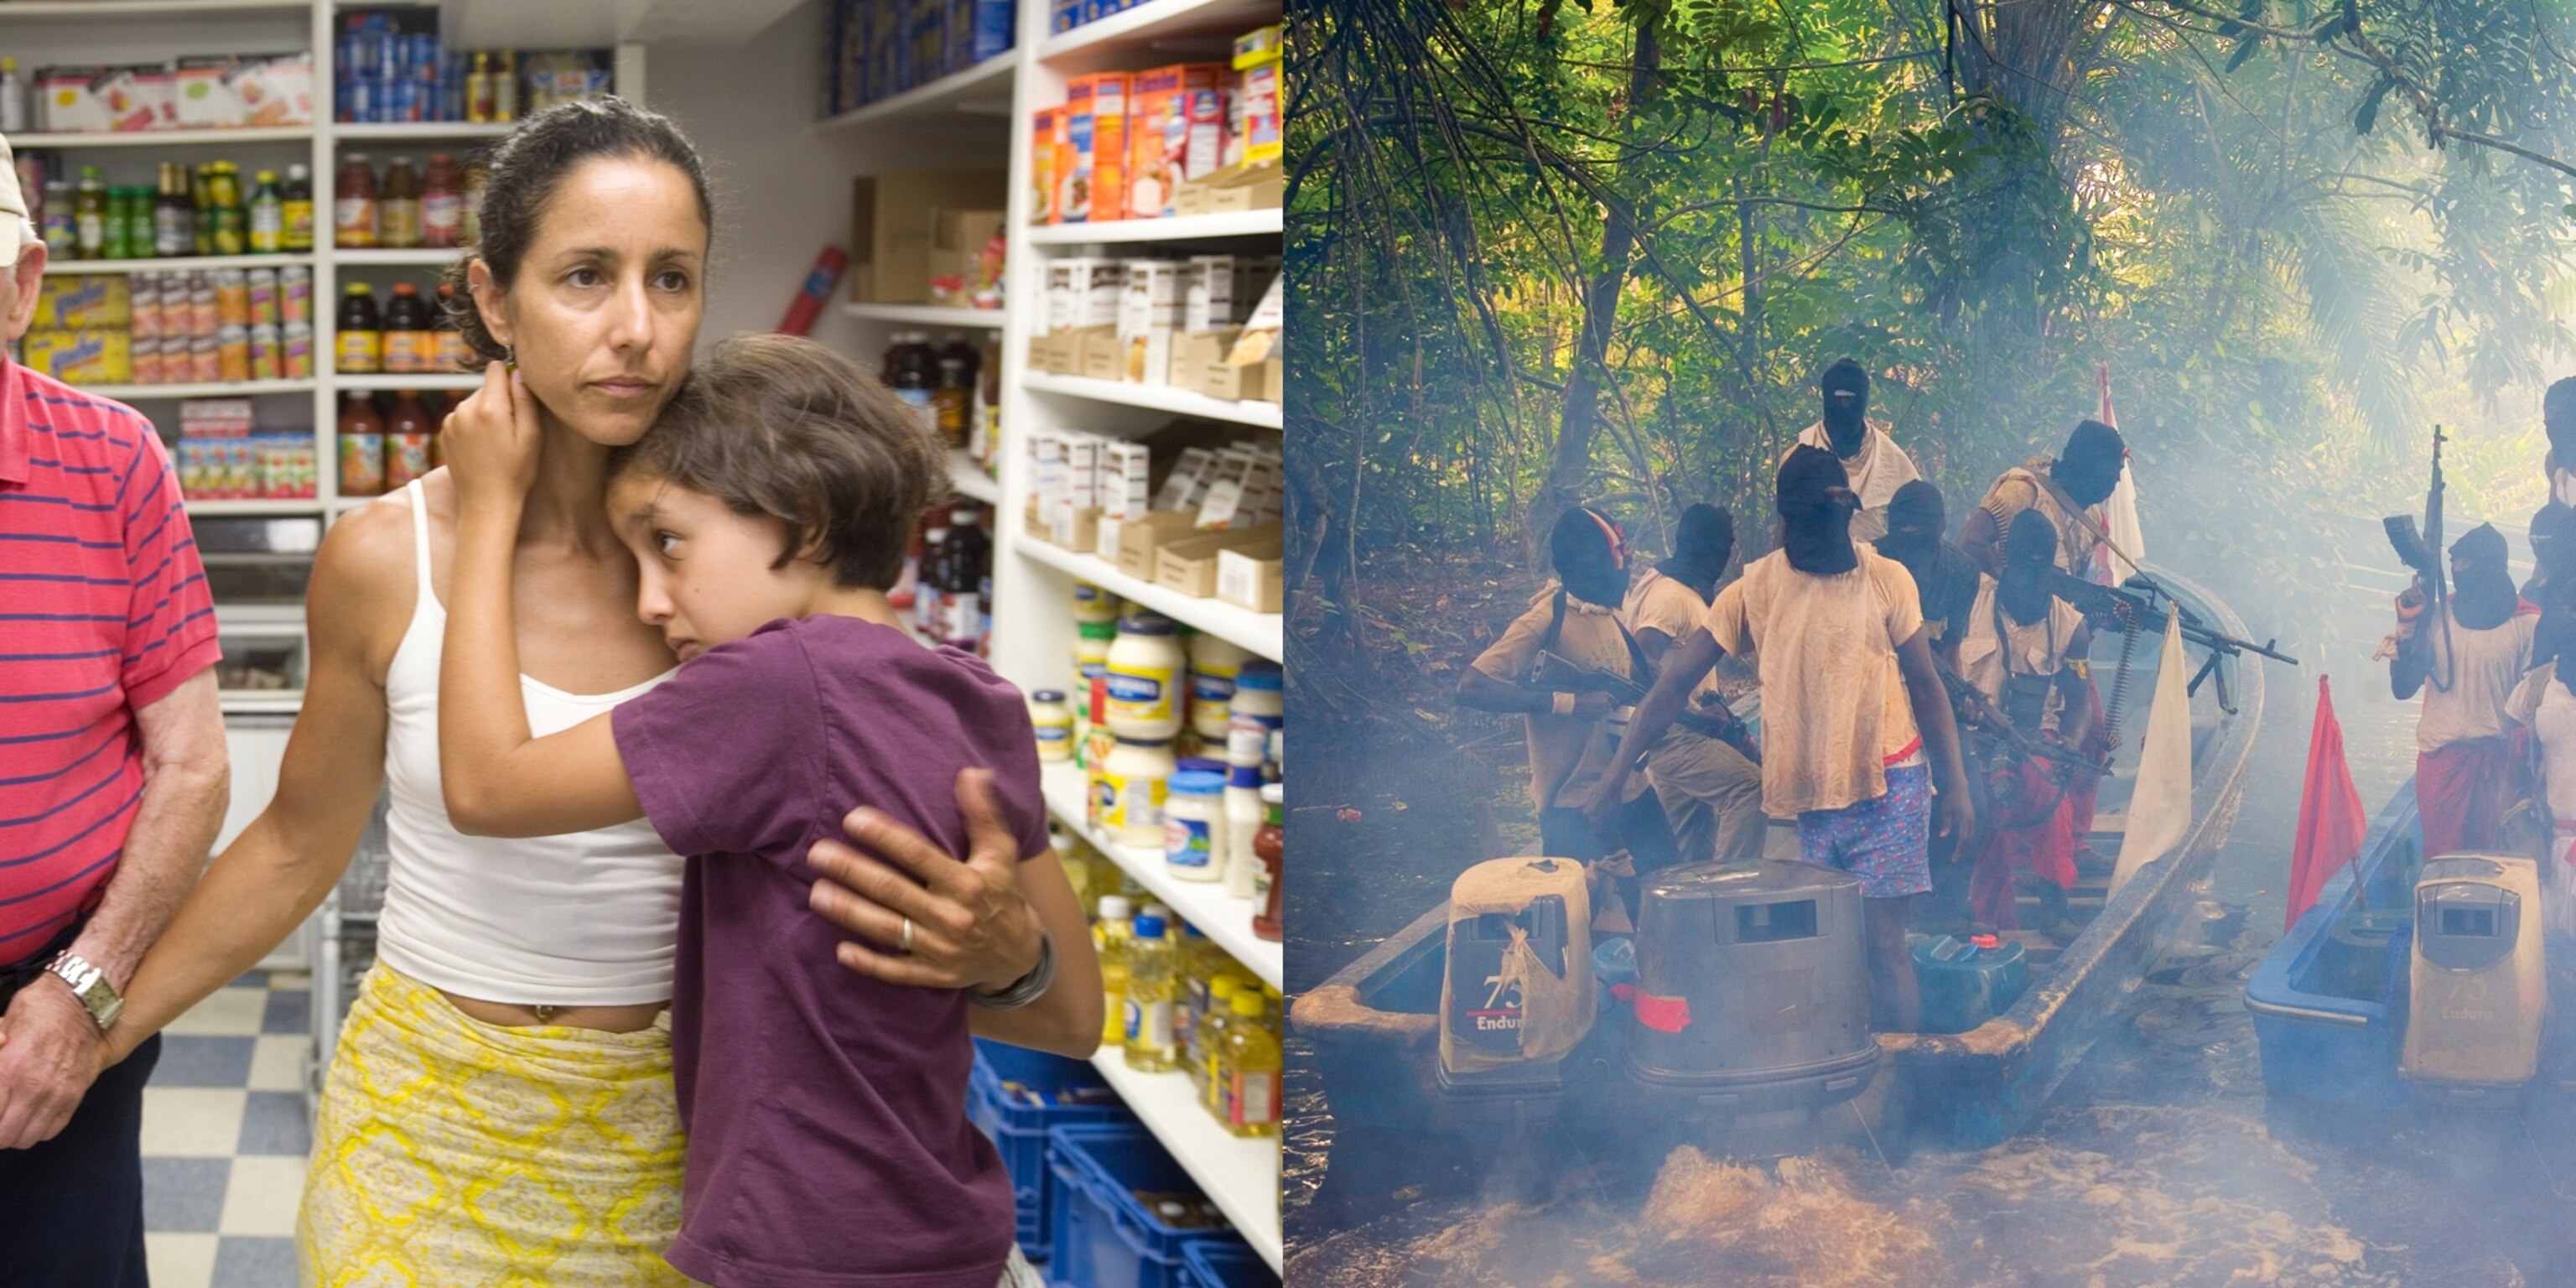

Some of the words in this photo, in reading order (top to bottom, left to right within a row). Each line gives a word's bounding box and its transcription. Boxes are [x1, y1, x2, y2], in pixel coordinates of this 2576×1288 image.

[1483, 975, 1523, 1010] 75
[2441, 1006, 2494, 1021] Enduro
[1477, 1015, 1533, 1031] Endur
